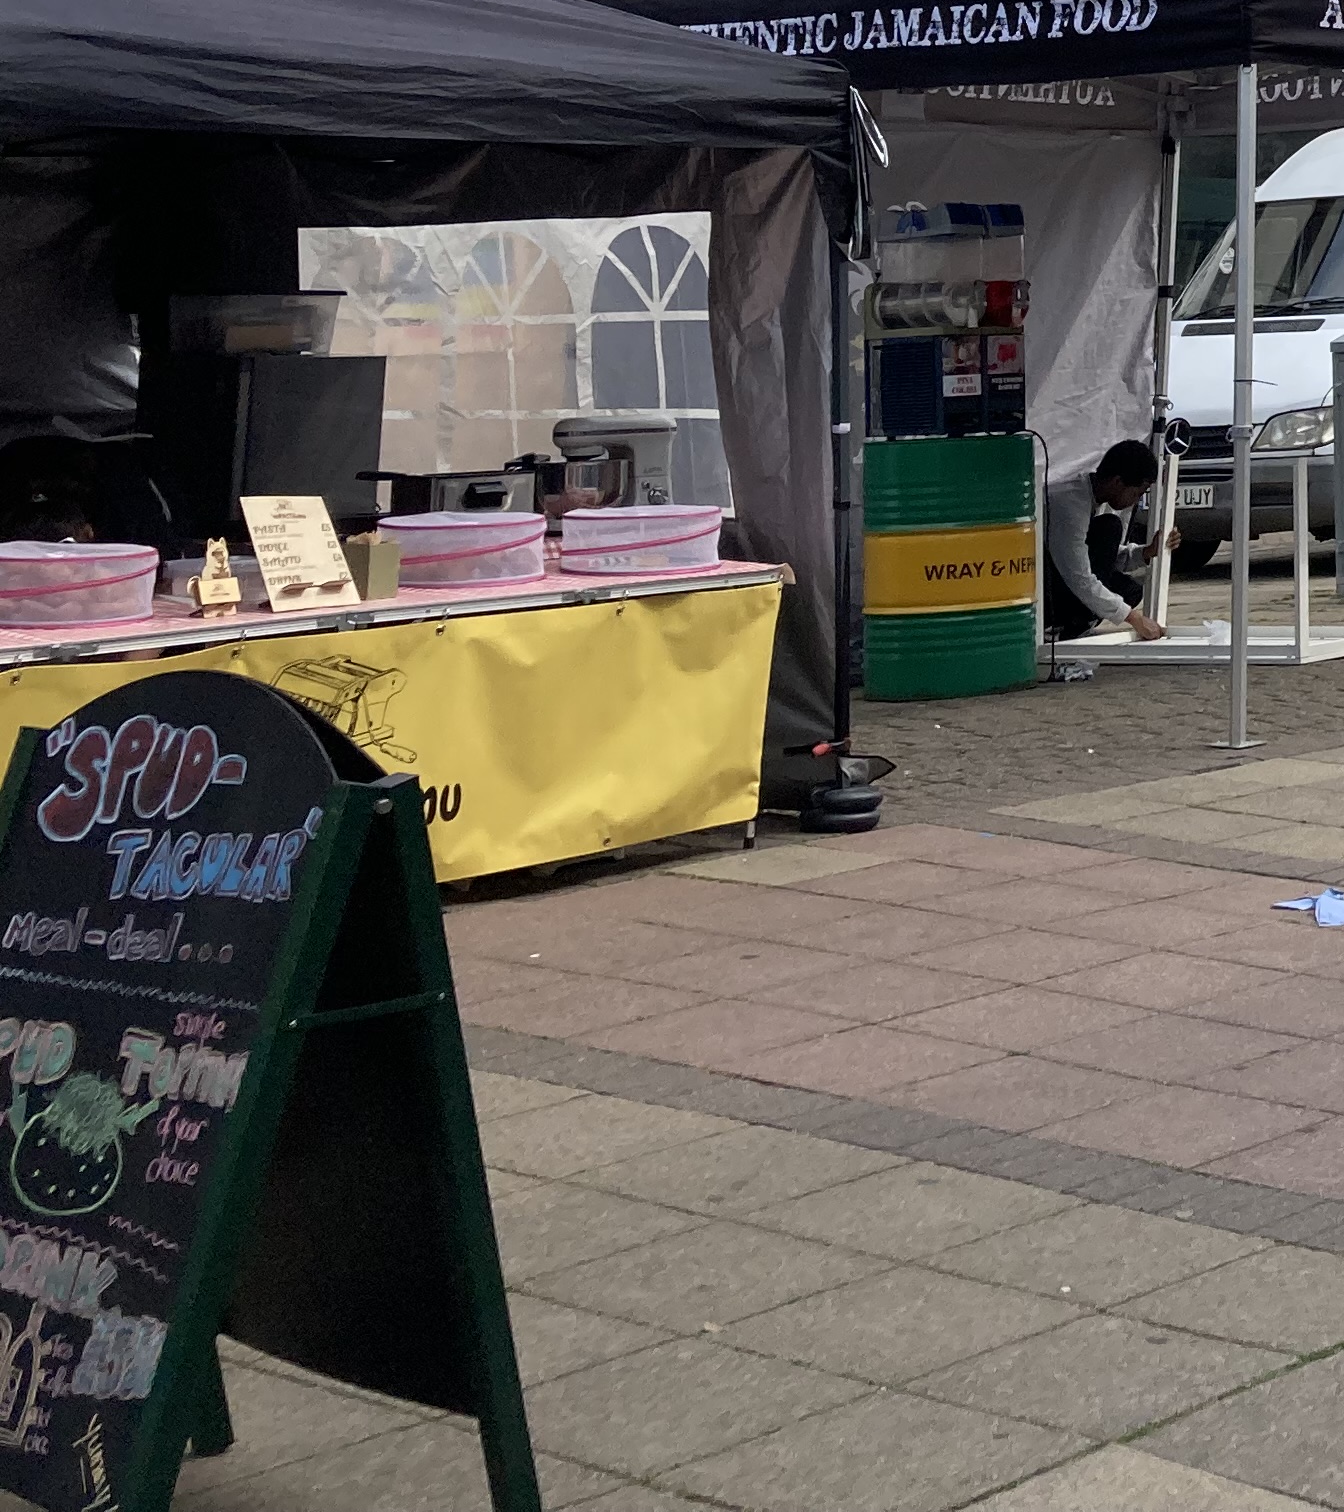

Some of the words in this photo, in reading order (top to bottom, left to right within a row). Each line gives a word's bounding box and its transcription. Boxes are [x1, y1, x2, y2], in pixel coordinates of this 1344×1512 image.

[843, 1, 1043, 50] JAMAICAN
[253, 524, 286, 535] PASTA
[924, 561, 985, 581] WRAY
[990, 560, 1005, 576] &
